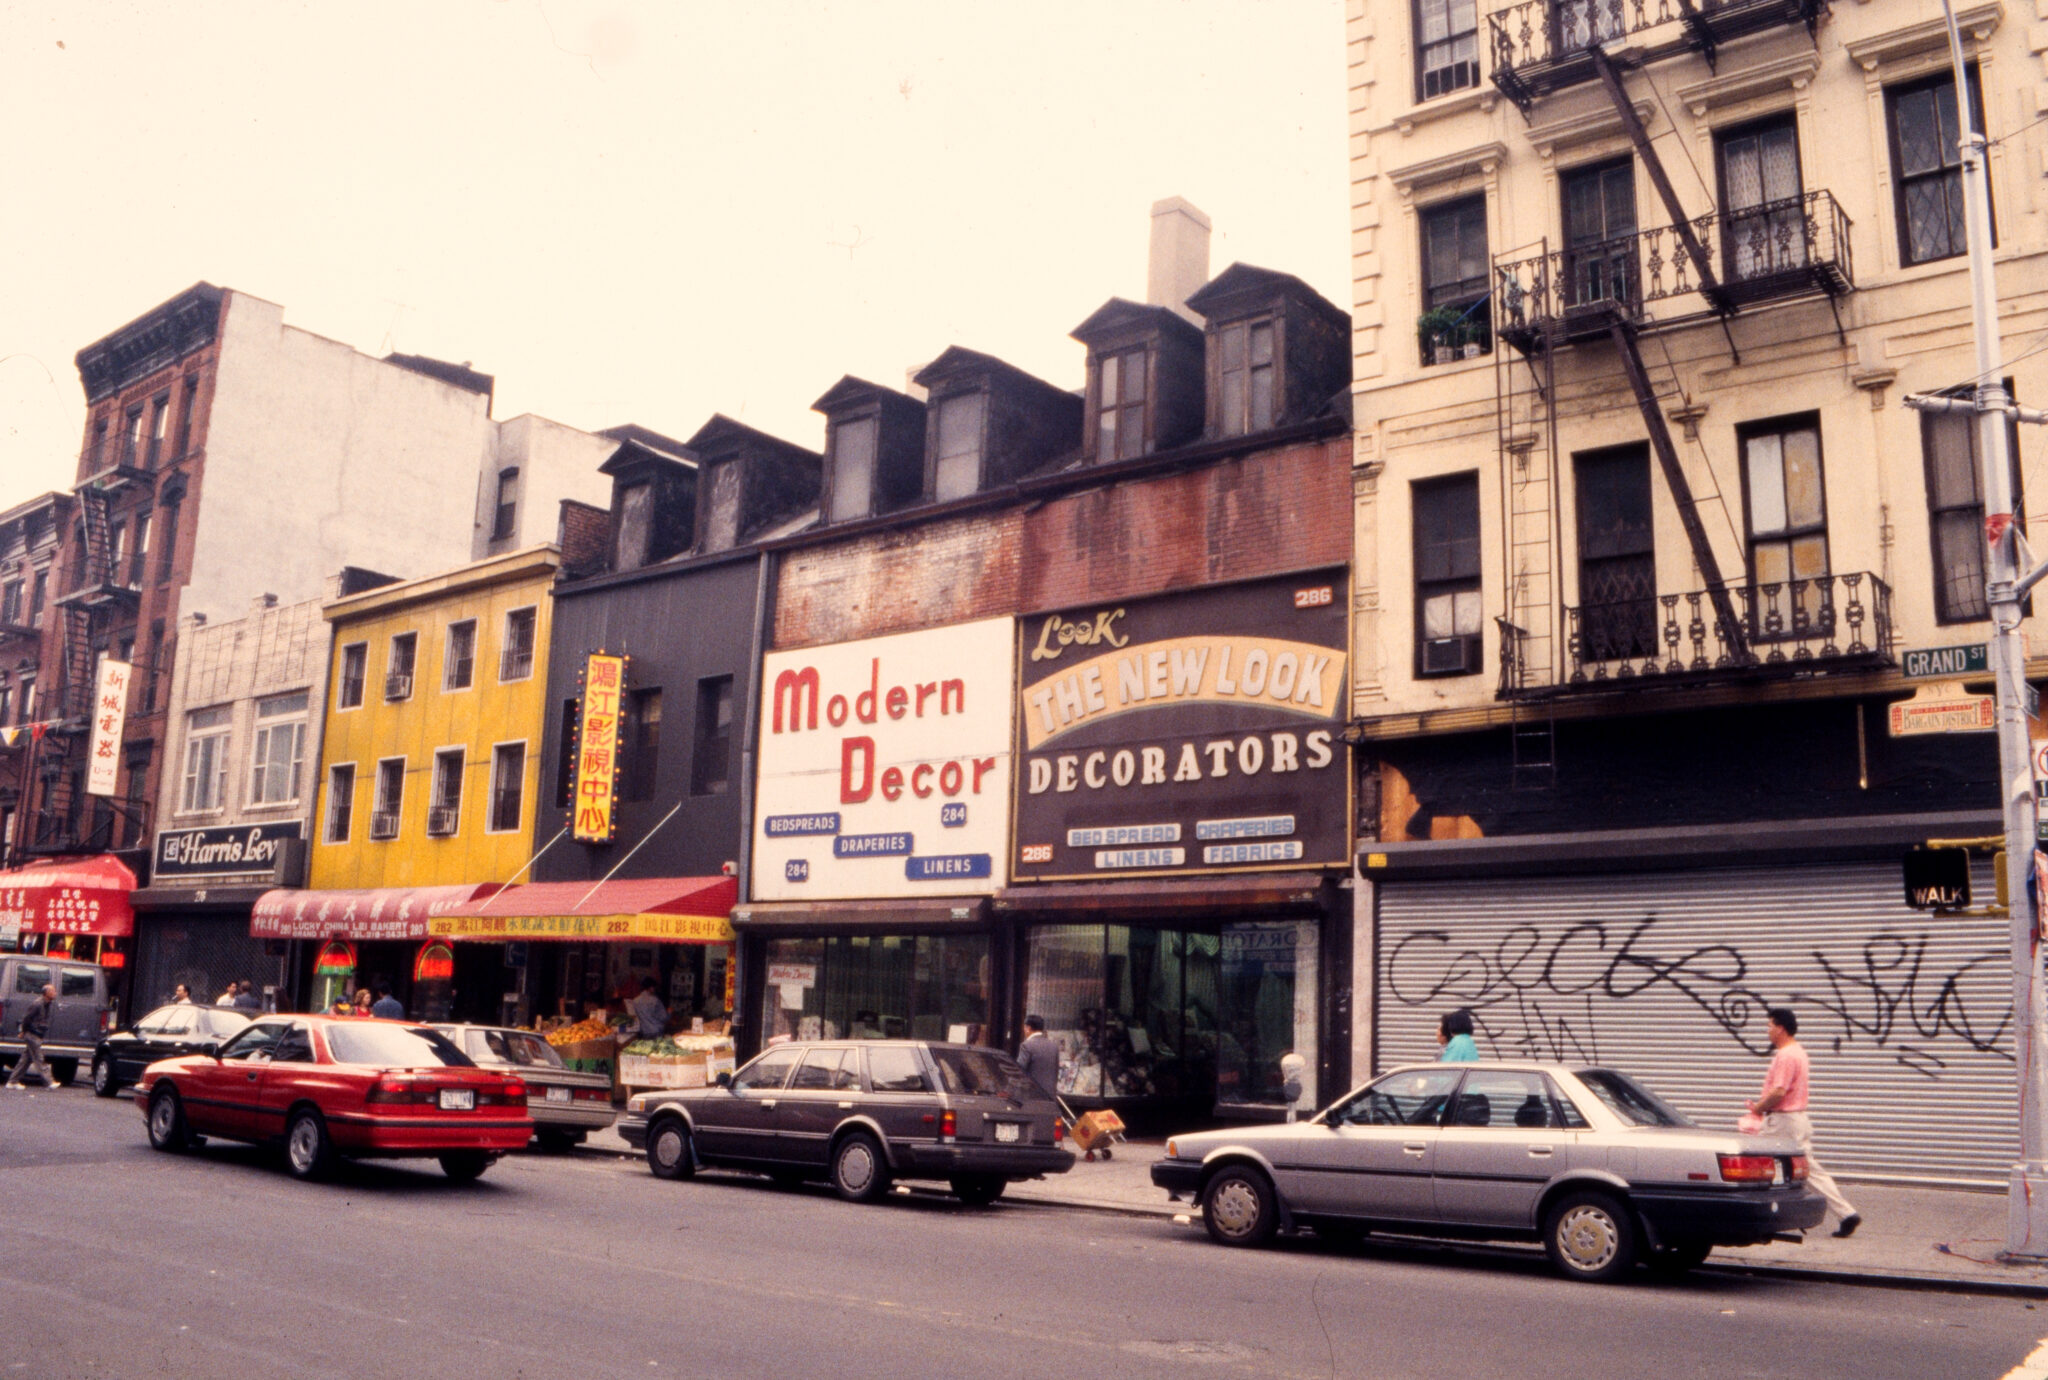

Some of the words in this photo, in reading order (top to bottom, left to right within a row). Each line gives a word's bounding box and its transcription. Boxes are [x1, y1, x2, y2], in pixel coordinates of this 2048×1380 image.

[1296, 588, 1331, 606] 286
[1907, 649, 1966, 676] GRAND
[1971, 646, 1985, 660] ST
[772, 657, 965, 734] Modern
[1032, 664, 1106, 734] THE
[1117, 646, 1209, 704] NEW
[1216, 645, 1330, 707] LOOK
[840, 736, 995, 805] Decor
[1029, 730, 1333, 794] DECORATORS
[943, 808, 965, 822] 284
[770, 816, 835, 832] BEDSPREADS
[1197, 818, 1294, 839] DRAPERIES
[180, 832, 243, 865] Harris
[242, 828, 279, 861] Lev
[841, 836, 906, 852] DRAPERIES
[1071, 831, 1103, 846] BED
[1023, 847, 1051, 861] 286
[1104, 850, 1173, 867] LINENS
[1210, 843, 1296, 863] FABRICS
[787, 863, 807, 877] 284
[923, 858, 971, 874] LINENS
[1912, 887, 1963, 904] WALK
[293, 922, 321, 931] LUCKY
[324, 922, 349, 931] CHINA
[371, 921, 408, 931] BAKERY
[435, 922, 452, 933] 282
[608, 921, 629, 932] 282
